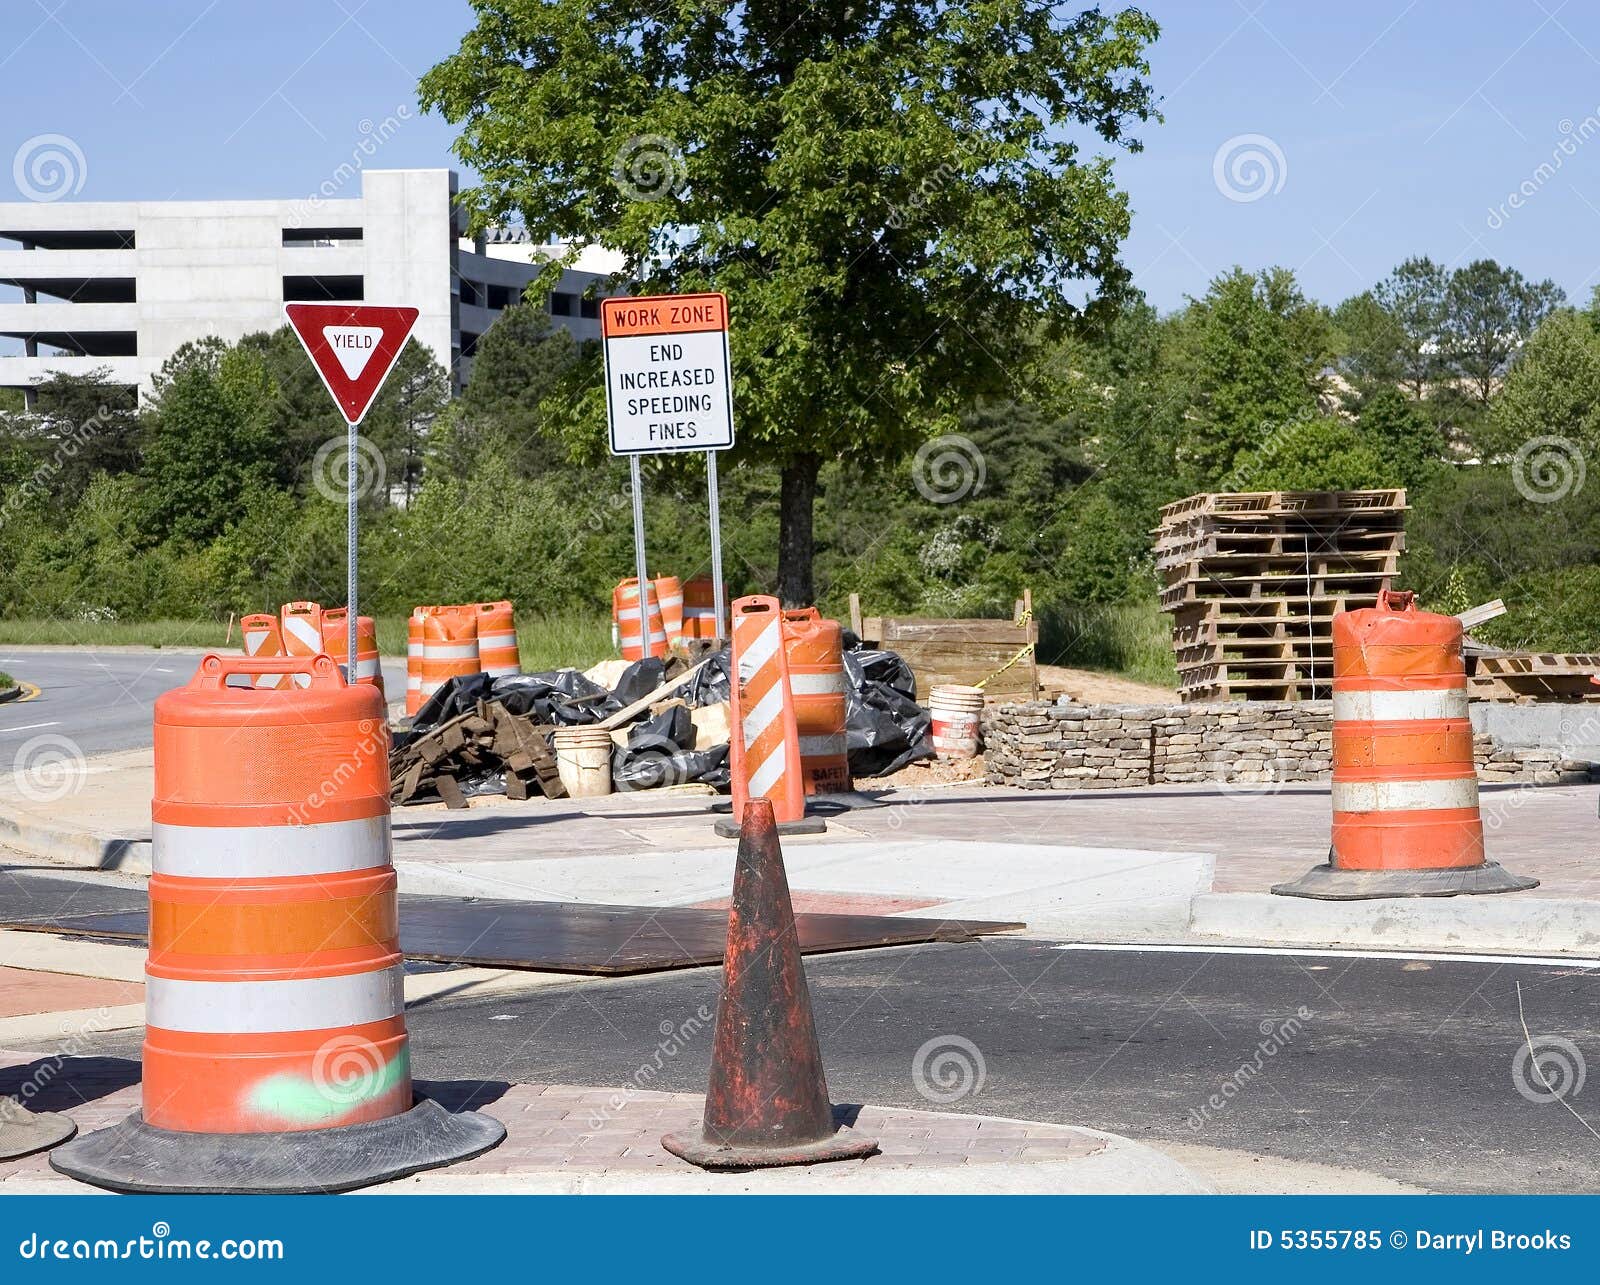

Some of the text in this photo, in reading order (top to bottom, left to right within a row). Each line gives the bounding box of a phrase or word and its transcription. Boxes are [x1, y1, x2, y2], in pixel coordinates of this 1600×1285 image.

[614, 305, 715, 328] WORK ZONE
[333, 334, 373, 349] YIELD
[650, 344, 683, 362] END
[620, 368, 715, 390] INCREASED
[627, 394, 712, 416] SPEEDING
[648, 421, 698, 441] FINES
